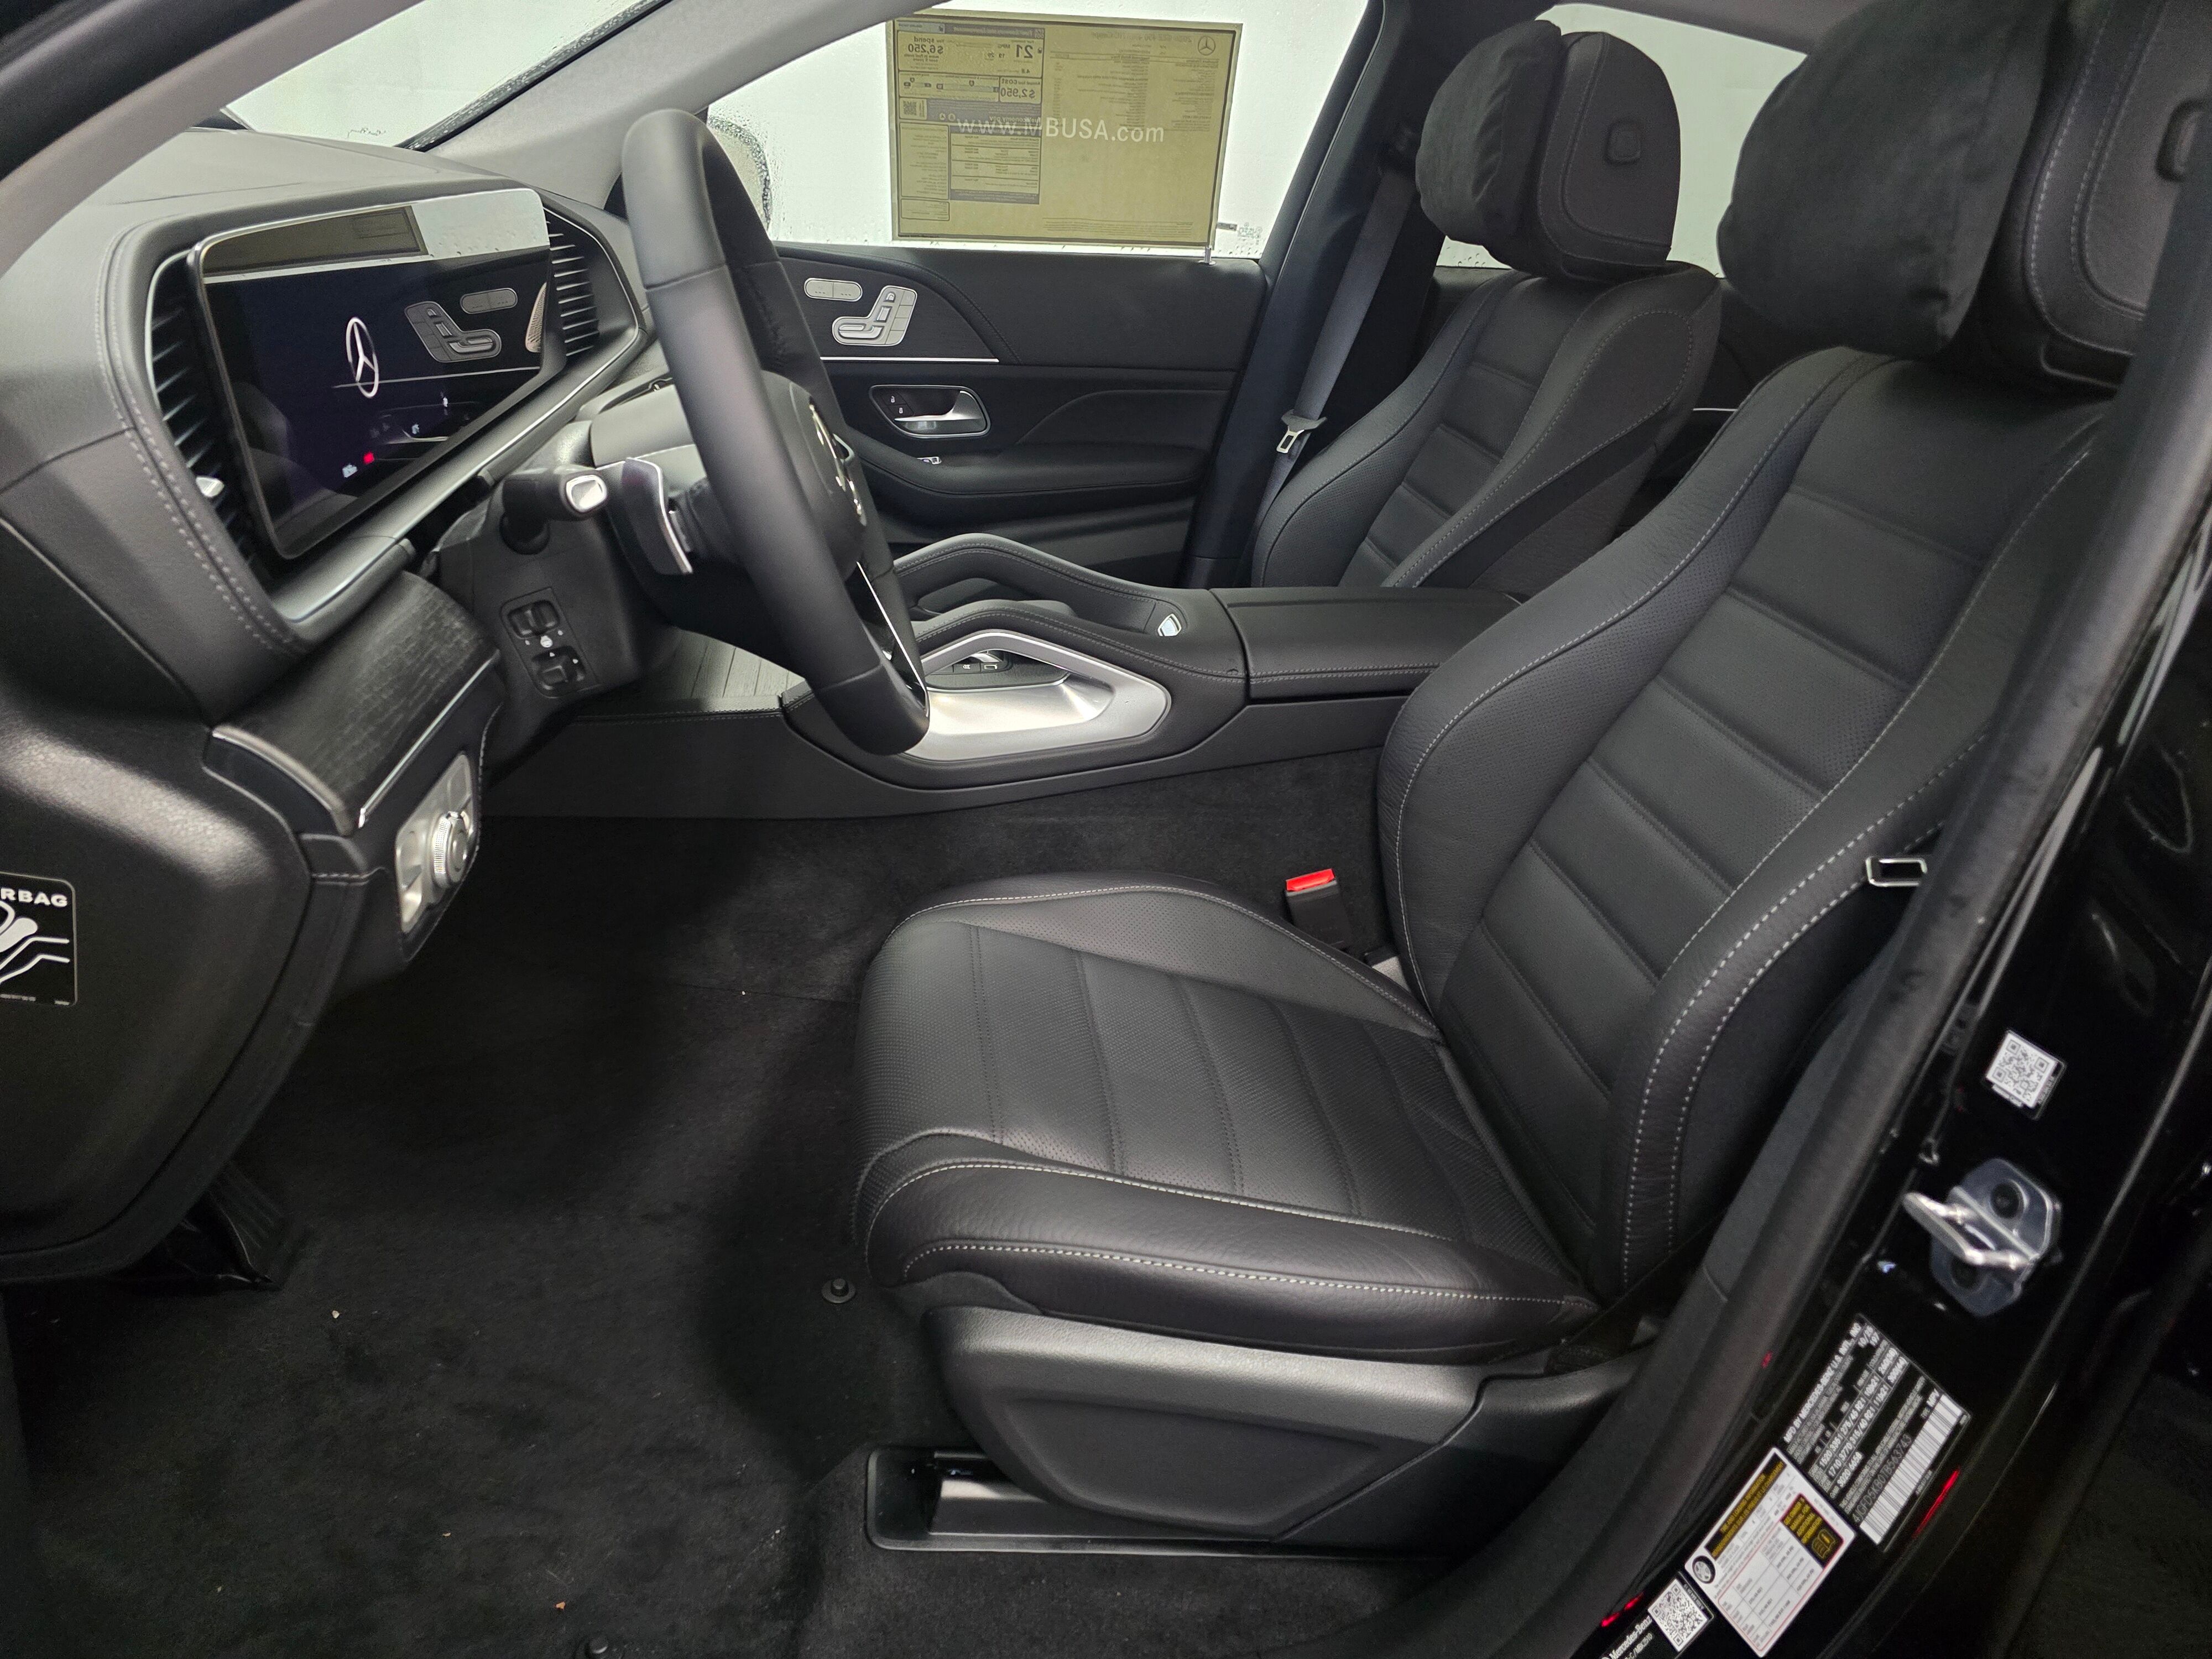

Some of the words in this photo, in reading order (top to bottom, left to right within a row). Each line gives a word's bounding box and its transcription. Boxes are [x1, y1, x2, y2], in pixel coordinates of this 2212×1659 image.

[1797, 1365, 1835, 1420] MERCEDES-BENZ
[1783, 1425, 1797, 1443] MFD
[1792, 1416, 1803, 1428] BY
[1819, 1449, 1833, 1468] 1520
[1829, 1433, 1843, 1451] 3351
[1854, 1396, 1866, 1411] R21
[1827, 1458, 1842, 1477] 1710
[1838, 1441, 1853, 1461] 3770
[1864, 1405, 1876, 1421] R21
[1836, 1468, 1851, 1488] 3020
[1847, 1450, 1863, 1470] 6658
[1609, 1615, 1653, 1659] Mercedes-Benz
